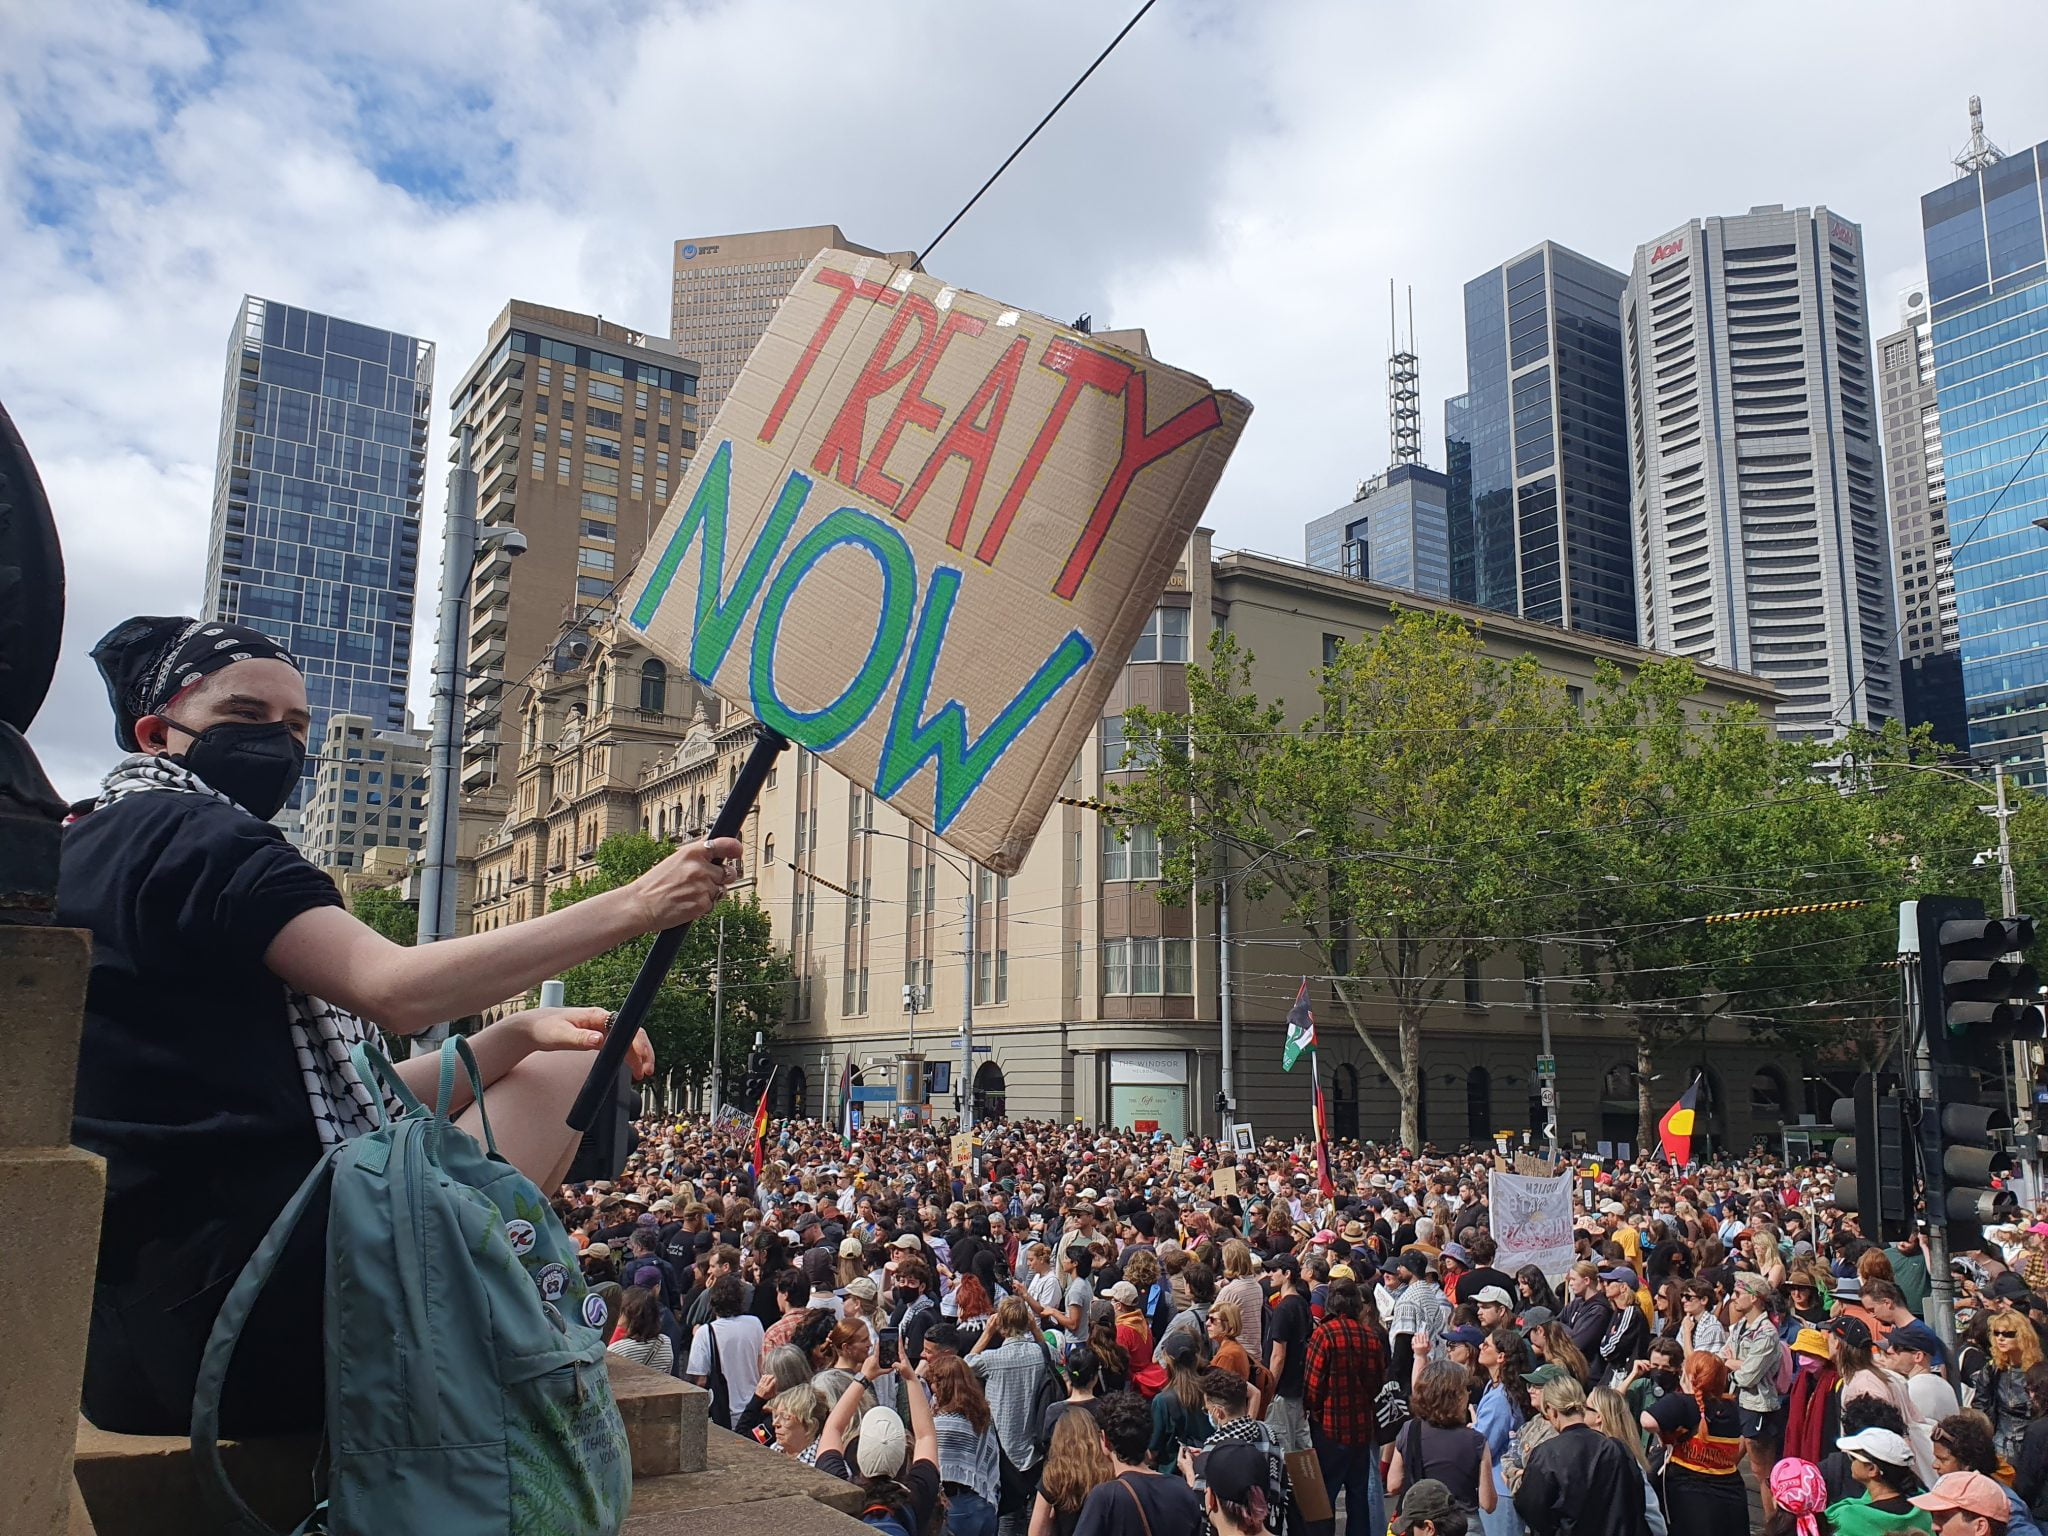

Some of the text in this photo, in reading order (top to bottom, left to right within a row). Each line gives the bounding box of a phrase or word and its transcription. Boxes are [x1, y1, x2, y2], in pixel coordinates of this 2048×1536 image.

[1832, 222, 1854, 247] AON
[698, 245, 720, 255] NTT
[1651, 238, 1684, 264] AON
[757, 266, 1223, 602] TREATY
[629, 440, 1096, 836] NOW
